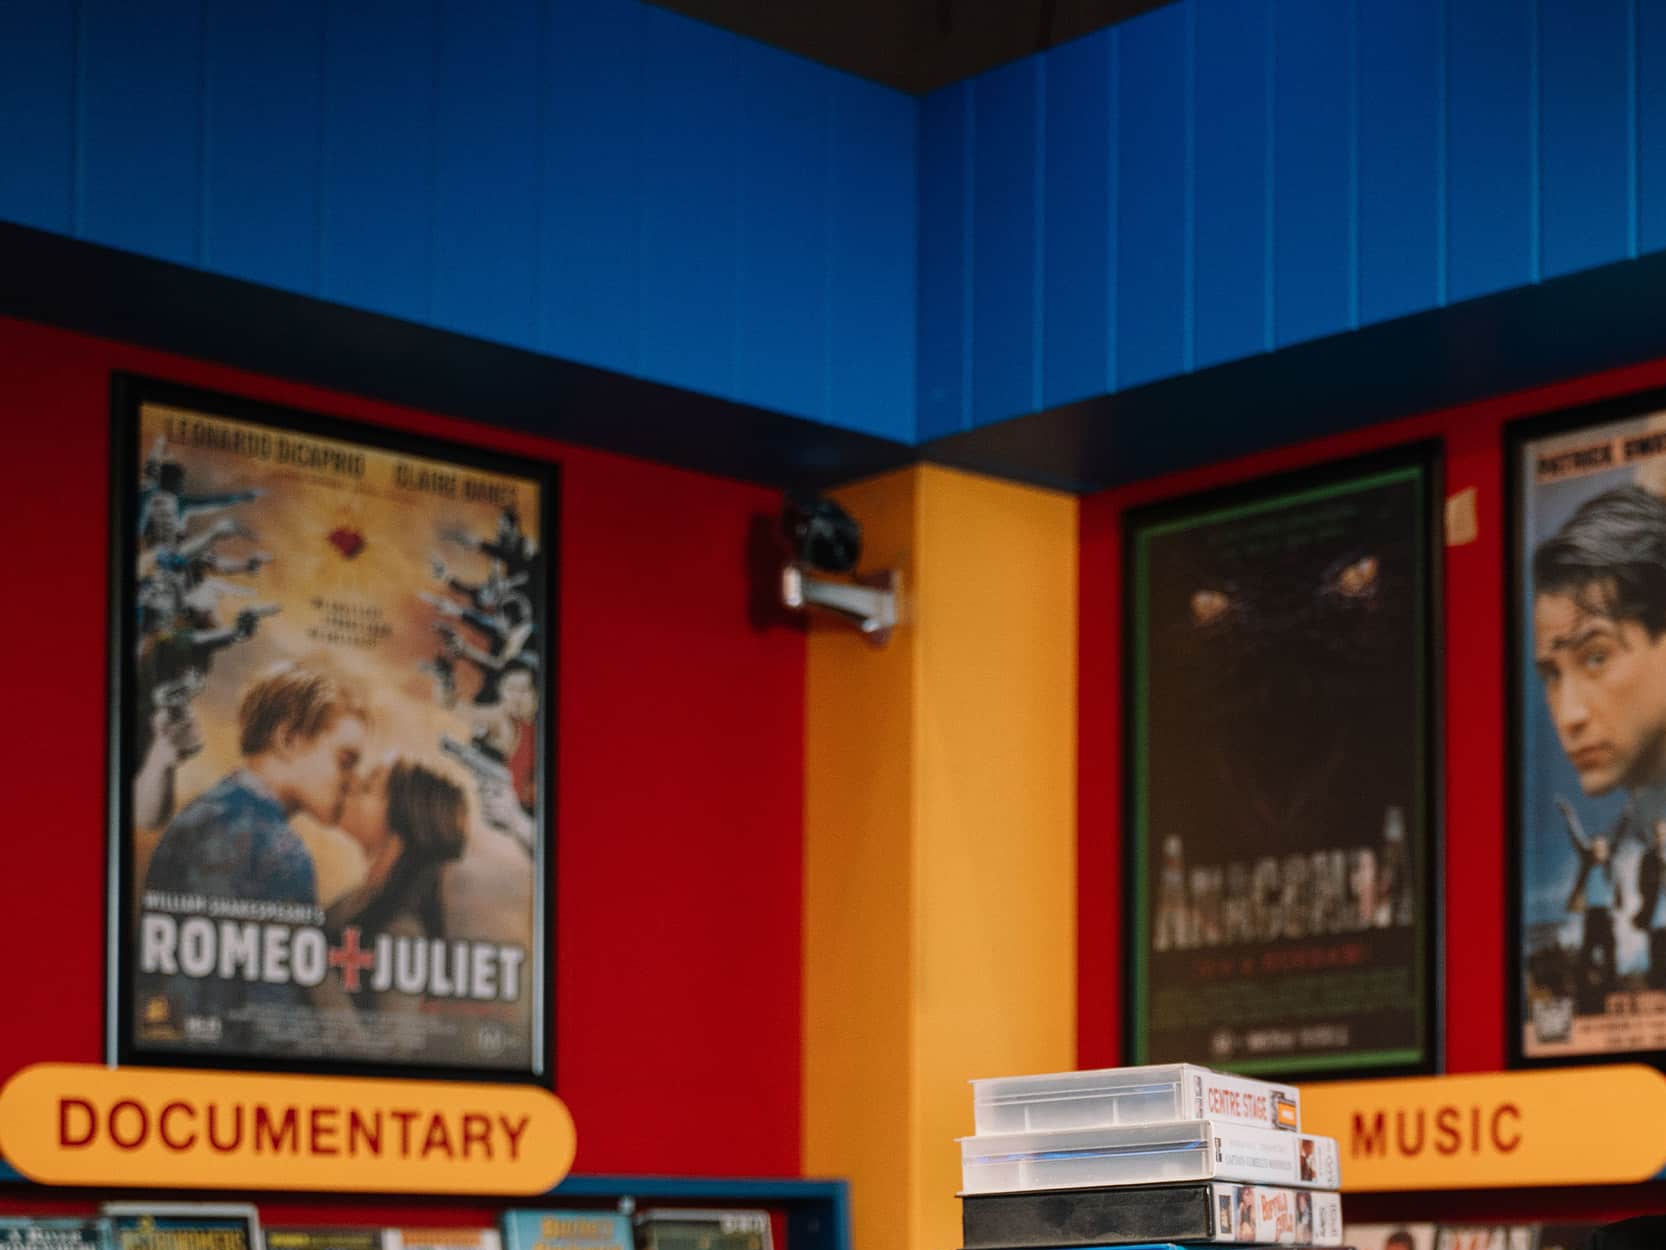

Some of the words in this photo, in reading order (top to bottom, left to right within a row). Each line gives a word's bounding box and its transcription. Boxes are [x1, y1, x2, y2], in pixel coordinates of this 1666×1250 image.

[57, 1096, 532, 1162] DOCUMENTARY
[1208, 1087, 1241, 1117] CENTRE
[1243, 1092, 1267, 1121] STAGE
[1351, 1103, 1523, 1159] MUSIC
